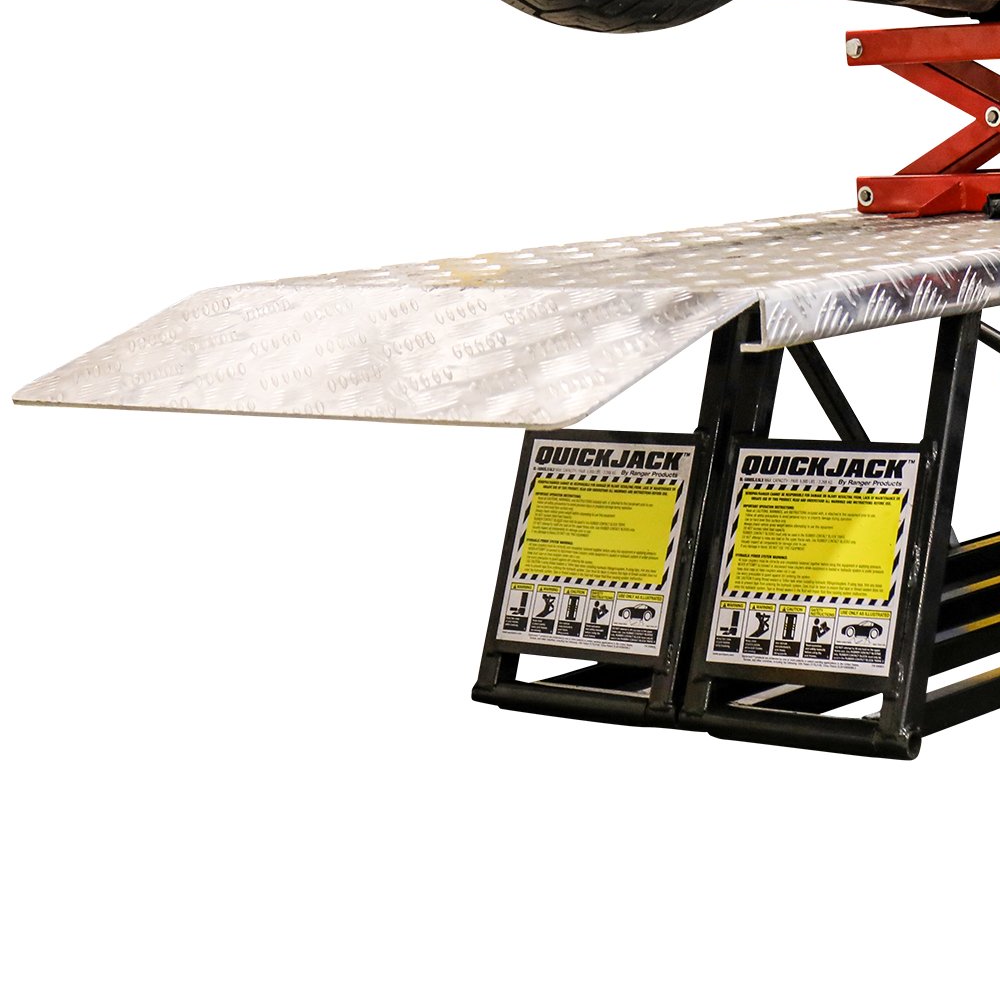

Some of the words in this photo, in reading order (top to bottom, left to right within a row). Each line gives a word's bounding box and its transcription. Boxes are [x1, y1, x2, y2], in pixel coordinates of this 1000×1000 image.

[629, 470, 650, 478] Ranger
[652, 471, 678, 479] Products
[838, 478, 847, 487] By
[848, 479, 871, 488] Ranger
[873, 479, 902, 488] Products
